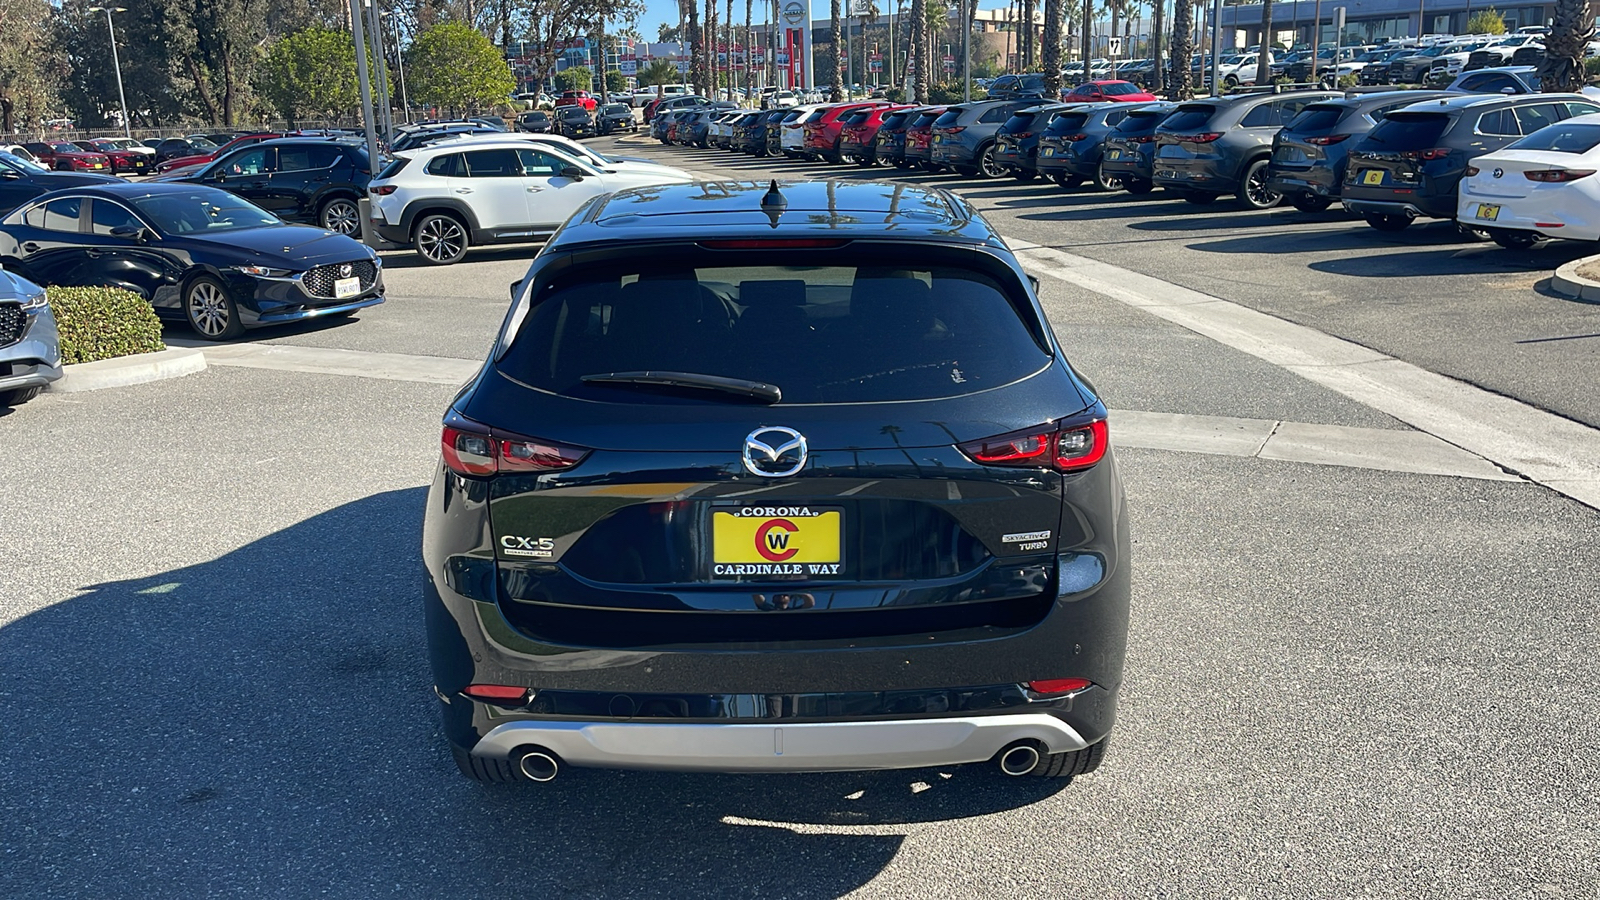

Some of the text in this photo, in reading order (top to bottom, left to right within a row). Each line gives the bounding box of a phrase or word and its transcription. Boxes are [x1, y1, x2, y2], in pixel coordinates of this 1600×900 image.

[741, 507, 812, 517] CORONA
[500, 535, 555, 550] CX-5
[755, 518, 799, 562] C
[767, 532, 790, 549] W
[1019, 541, 1048, 551] TURBO
[714, 564, 840, 575] CARDINALE WAY
